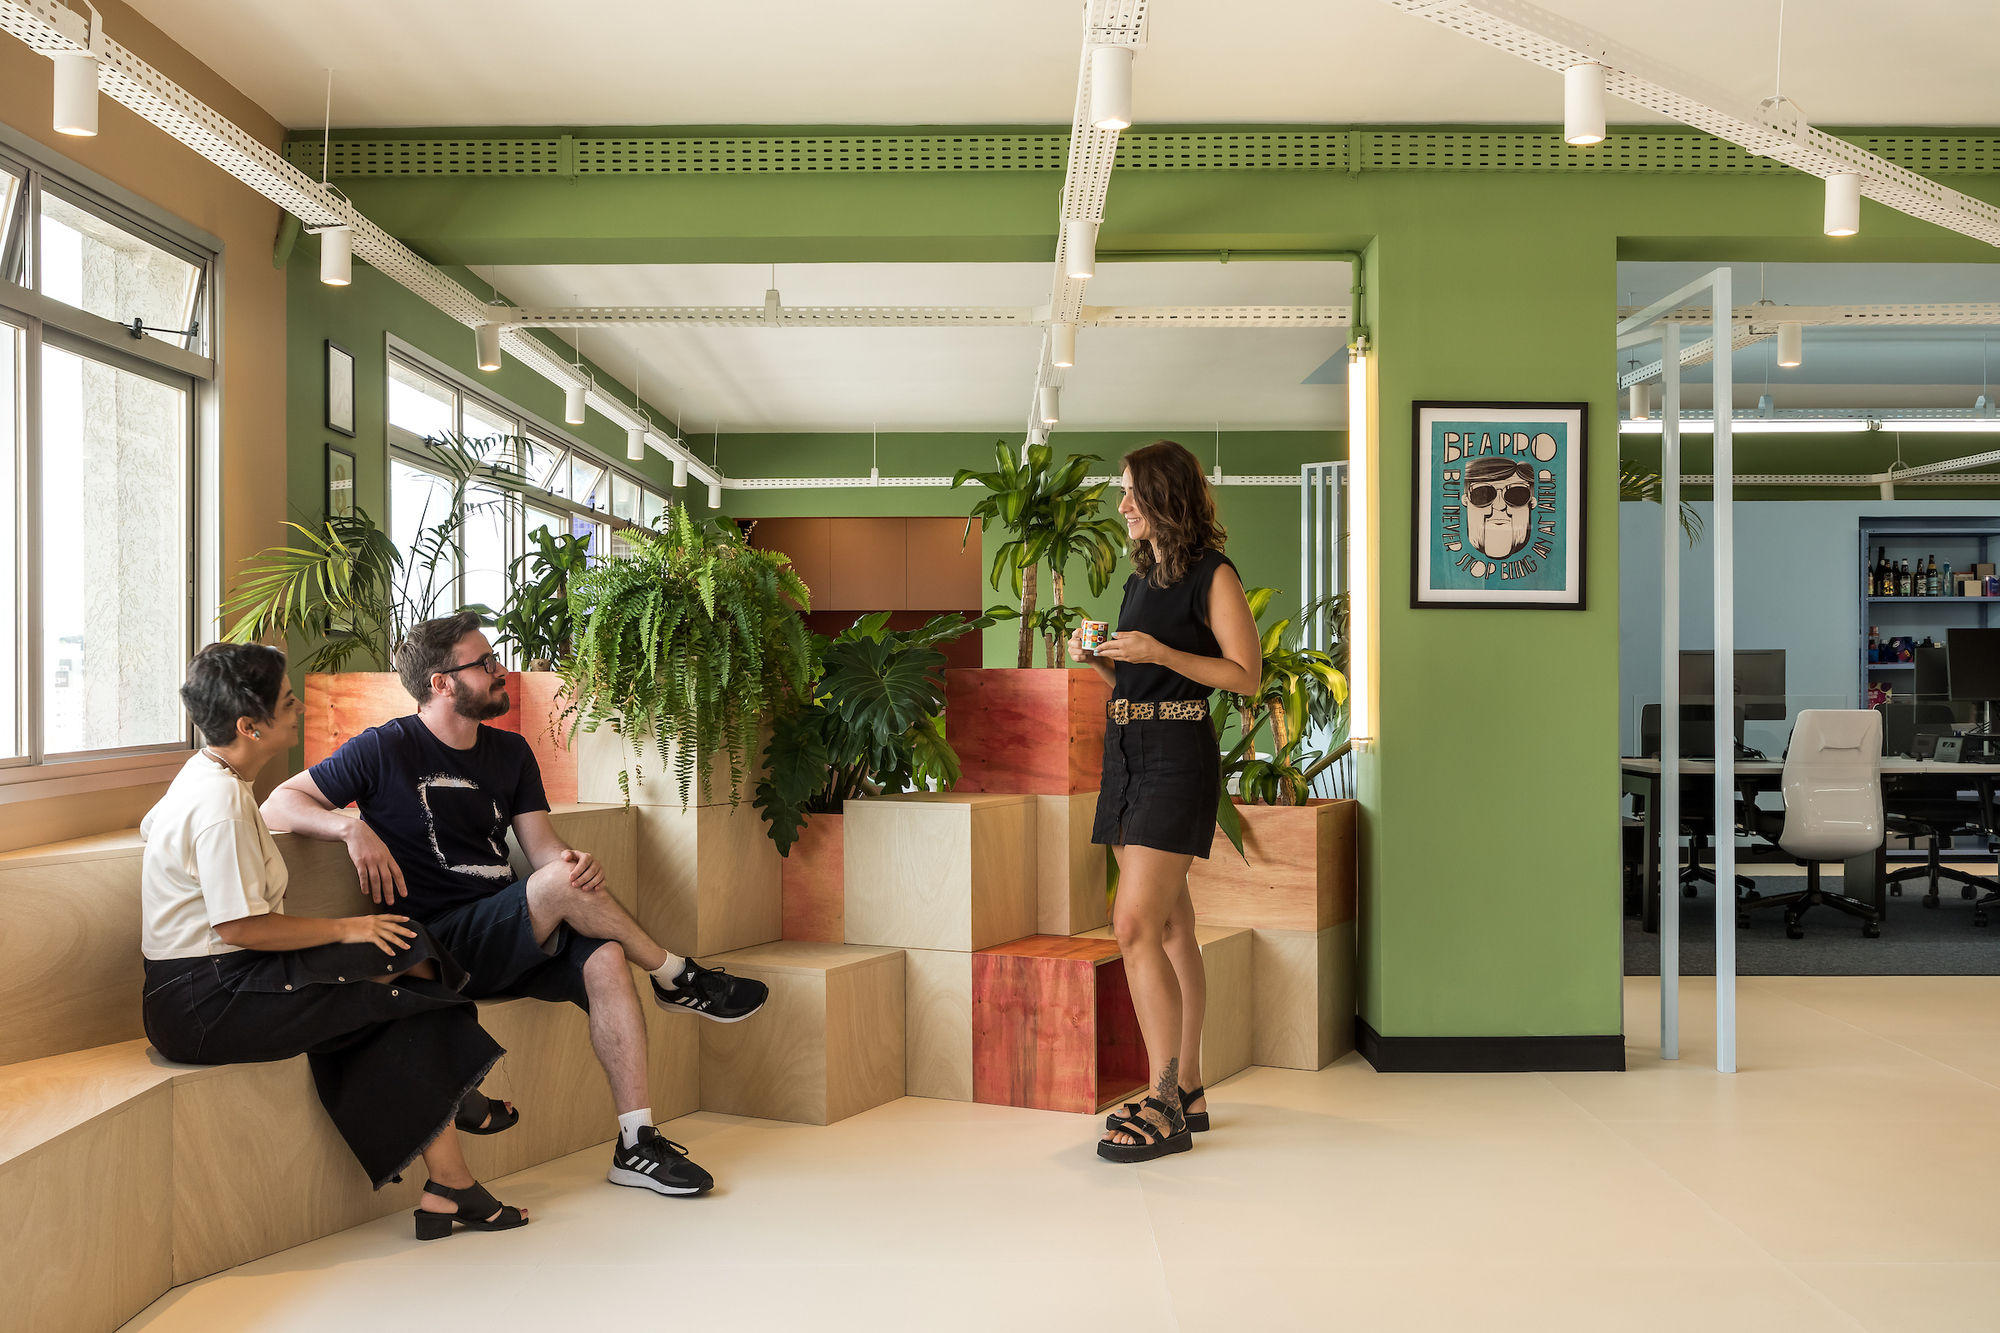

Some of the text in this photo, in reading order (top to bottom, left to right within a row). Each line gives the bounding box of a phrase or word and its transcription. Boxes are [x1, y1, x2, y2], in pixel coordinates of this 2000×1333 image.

[1443, 432, 1557, 464] BE A PRO
[1443, 469, 1461, 500] BUT
[1537, 469, 1557, 537] AMATEUR
[1442, 506, 1462, 552] NEVER
[1455, 553, 1496, 580] STOP
